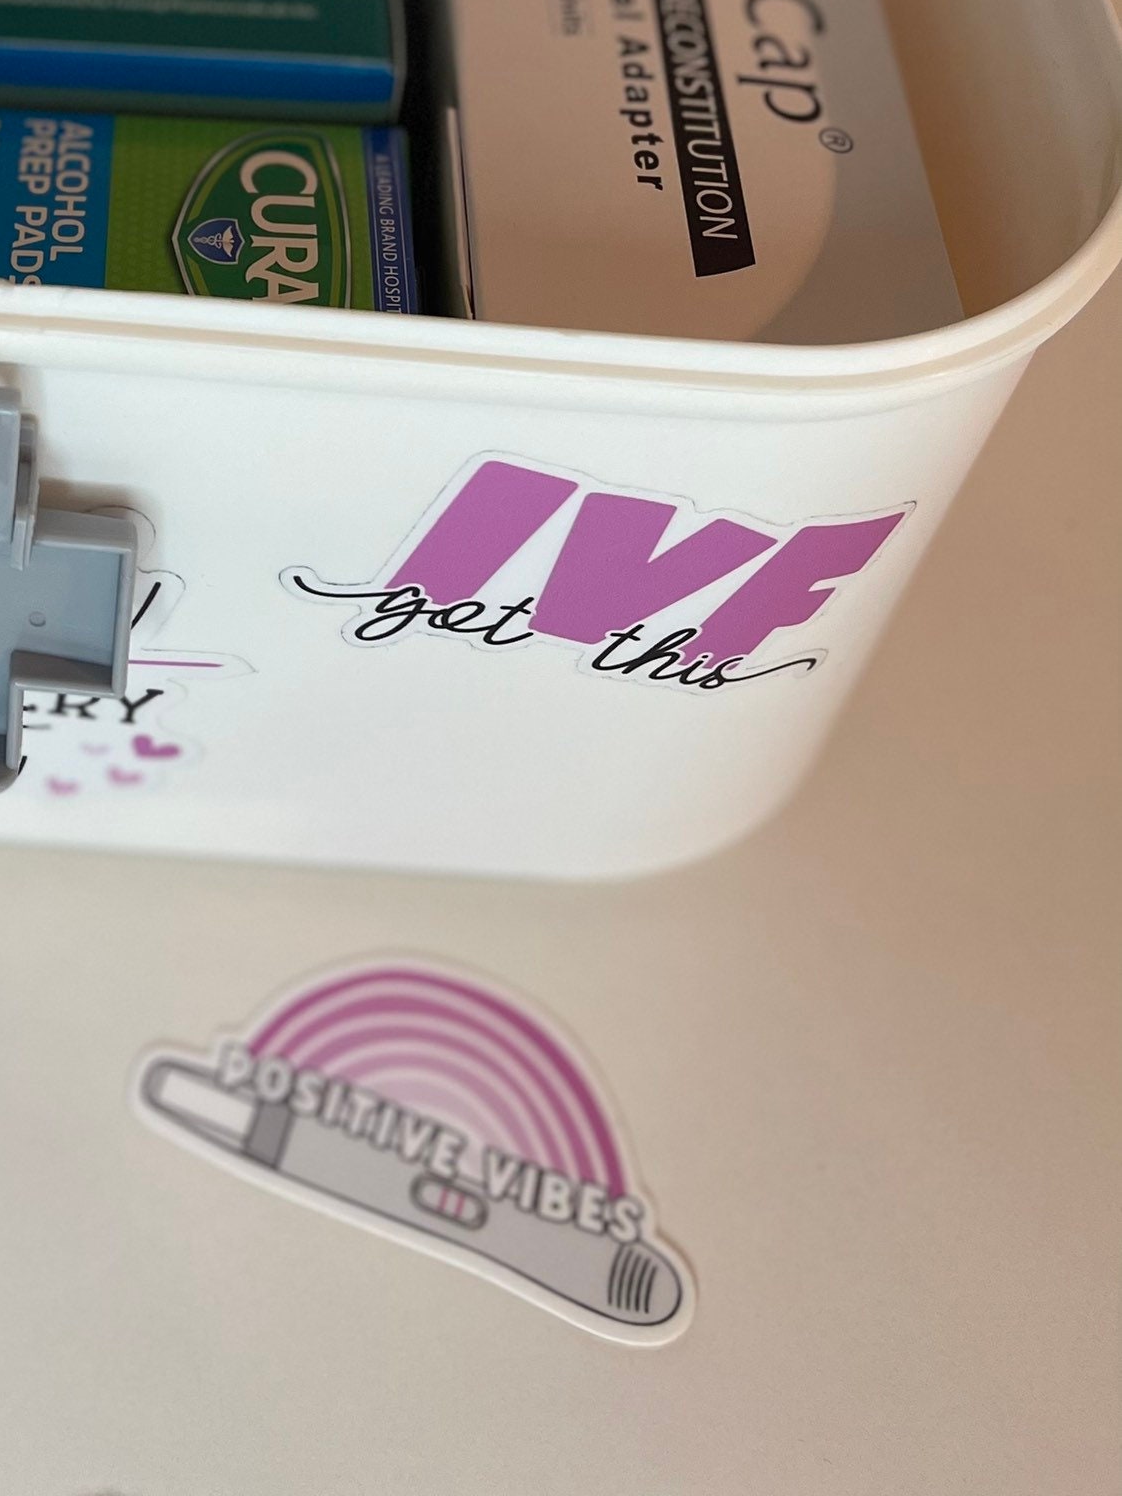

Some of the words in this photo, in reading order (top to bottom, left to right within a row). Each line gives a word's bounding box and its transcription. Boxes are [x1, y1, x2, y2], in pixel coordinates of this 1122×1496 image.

[18, 117, 57, 194] PREP
[617, 34, 664, 192] Adapter
[50, 119, 93, 261] ALCOHOL
[240, 150, 319, 303] CURA
[380, 218, 398, 262] BRAND
[383, 460, 906, 669] IVF
[591, 624, 816, 689] this
[218, 1044, 468, 1180] POSITIVE
[481, 1147, 646, 1244] VIBES
